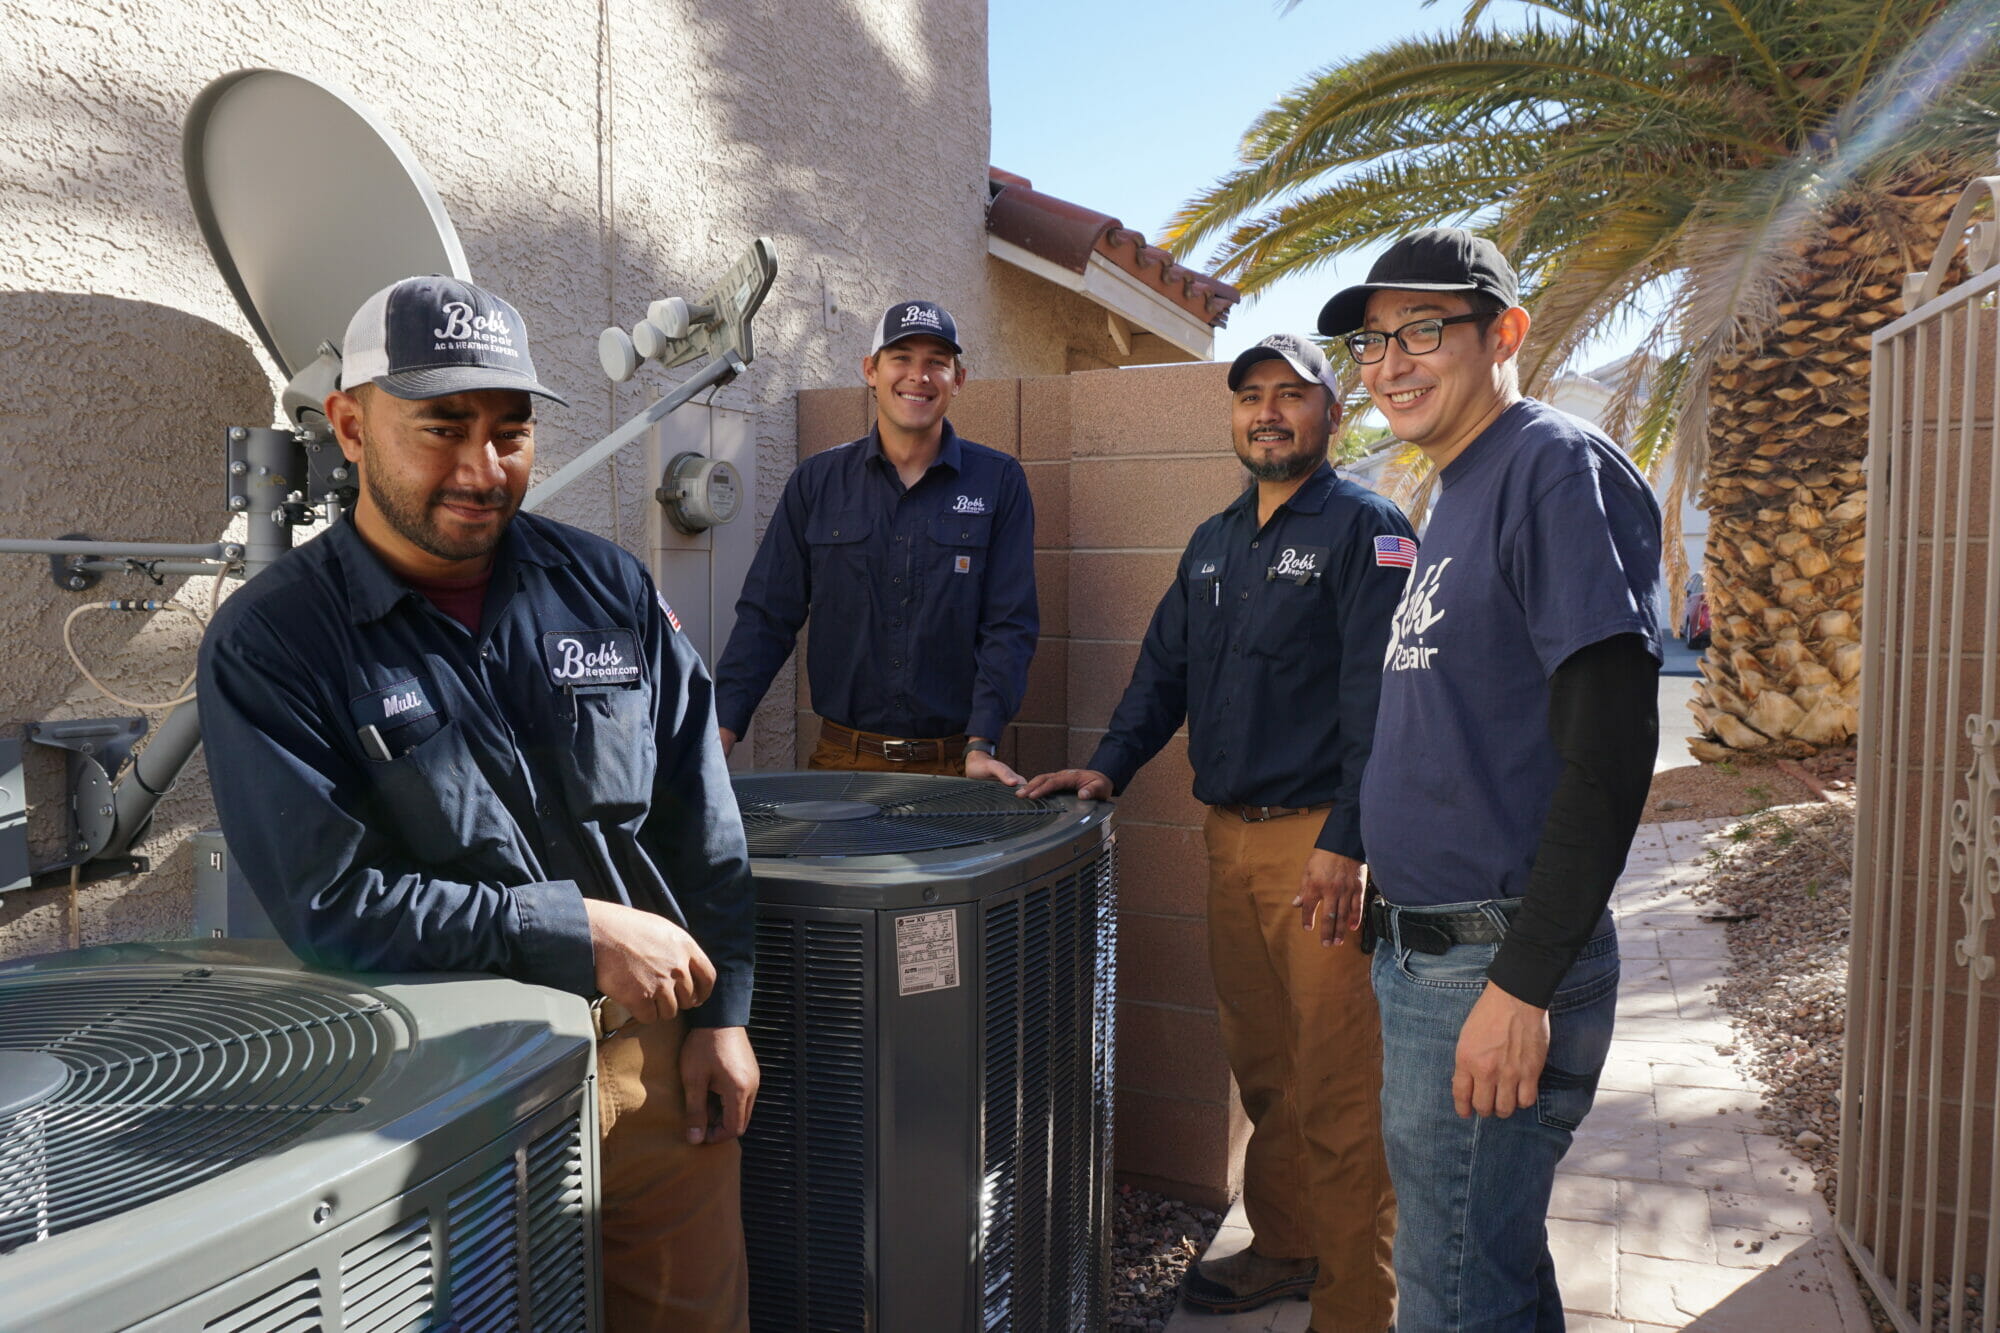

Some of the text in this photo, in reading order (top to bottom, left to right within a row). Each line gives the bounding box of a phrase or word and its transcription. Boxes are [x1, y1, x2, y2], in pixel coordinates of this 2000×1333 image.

[434, 302, 509, 339] Bob's
[901, 305, 939, 322] Bob's
[434, 342, 446, 350] AC
[953, 495, 985, 510] Bob's
[1277, 548, 1316, 574] Bob's
[553, 638, 623, 678] Bob's
[585, 666, 639, 678] Repair.com
